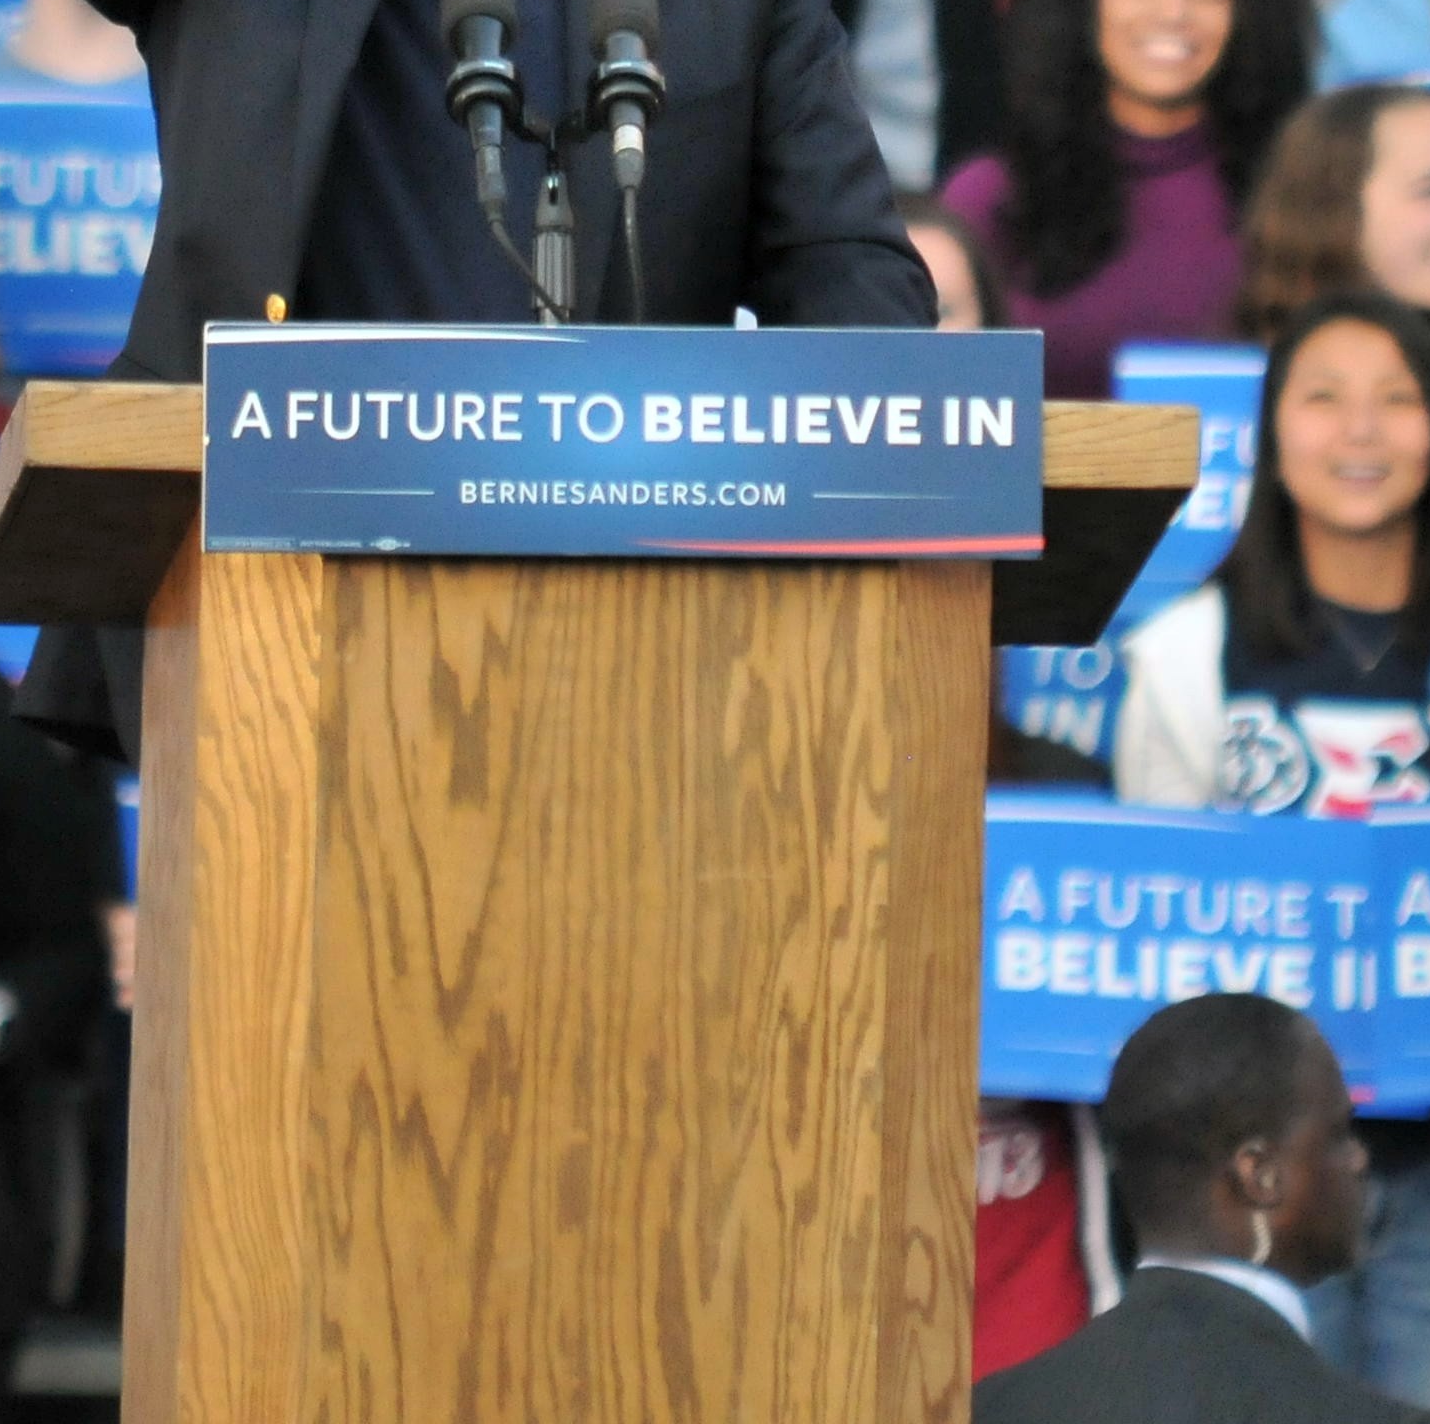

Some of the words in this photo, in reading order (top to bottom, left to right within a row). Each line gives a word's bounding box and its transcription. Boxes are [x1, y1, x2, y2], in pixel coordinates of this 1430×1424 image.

[231, 390, 272, 440] A
[286, 391, 524, 442] FUTURE
[537, 392, 626, 444] TO
[642, 392, 923, 445] BELIEVE
[943, 396, 1014, 447] IN
[459, 479, 787, 507] BERNIESANDERS.COM
[1026, 643, 1114, 690] TO
[1022, 696, 1106, 757] IN
[998, 866, 1045, 924] A
[1057, 869, 1314, 940] FUTURE
[994, 927, 1317, 1010] BELIEVE
